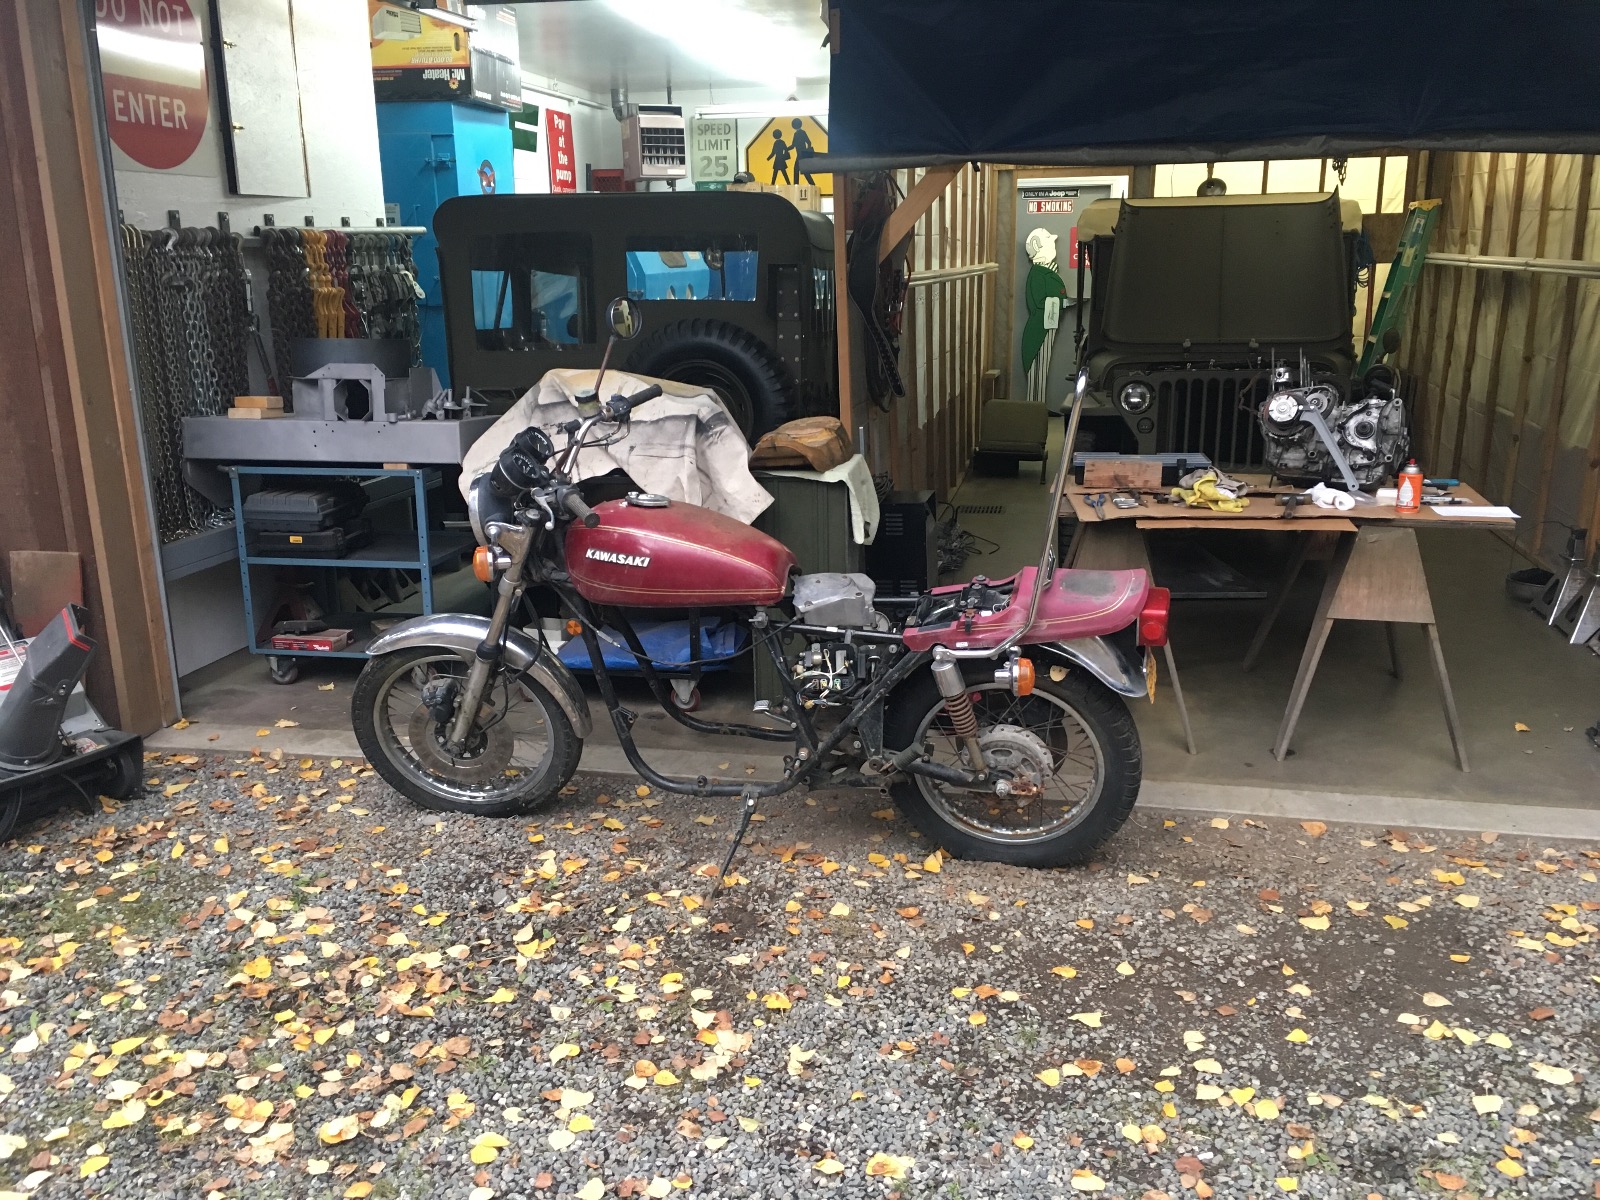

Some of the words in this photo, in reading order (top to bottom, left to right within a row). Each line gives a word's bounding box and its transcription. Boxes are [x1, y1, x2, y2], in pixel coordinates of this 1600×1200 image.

[140, 0, 184, 36] NOT
[422, 68, 450, 81] Heater
[451, 68, 466, 80] Mr.
[112, 89, 189, 130] ENTER
[553, 113, 566, 133] Pay
[697, 123, 731, 136] SPEED
[558, 135, 566, 148] at
[697, 138, 731, 151] LIMIT
[557, 150, 569, 166] the
[699, 155, 729, 178] 25
[555, 168, 572, 184] pump
[1049, 190, 1065, 198] Jeep
[1028, 201, 1038, 212] NO
[1041, 201, 1072, 212] SMOKING
[585, 548, 651, 568] KAWASAKI
